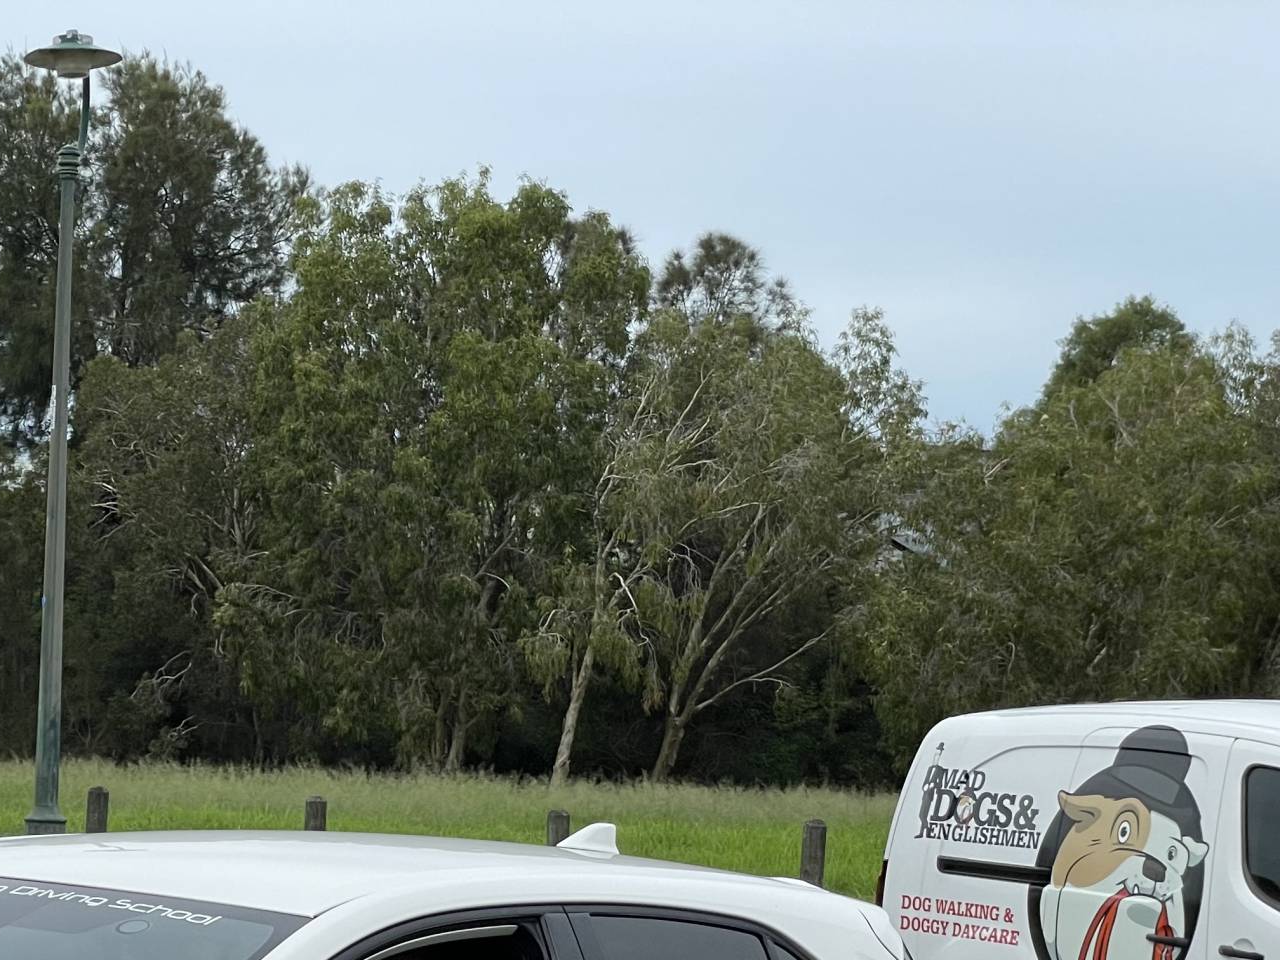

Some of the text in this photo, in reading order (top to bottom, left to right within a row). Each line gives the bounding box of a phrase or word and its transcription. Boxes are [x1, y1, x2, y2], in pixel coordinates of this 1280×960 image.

[940, 768, 986, 791] MAD
[926, 822, 1041, 850] ENGLISHMEN
[9, 886, 109, 907] Driving
[901, 895, 1014, 923] DOG WALKING &
[900, 915, 1020, 946] DOGGY DAYCARE
